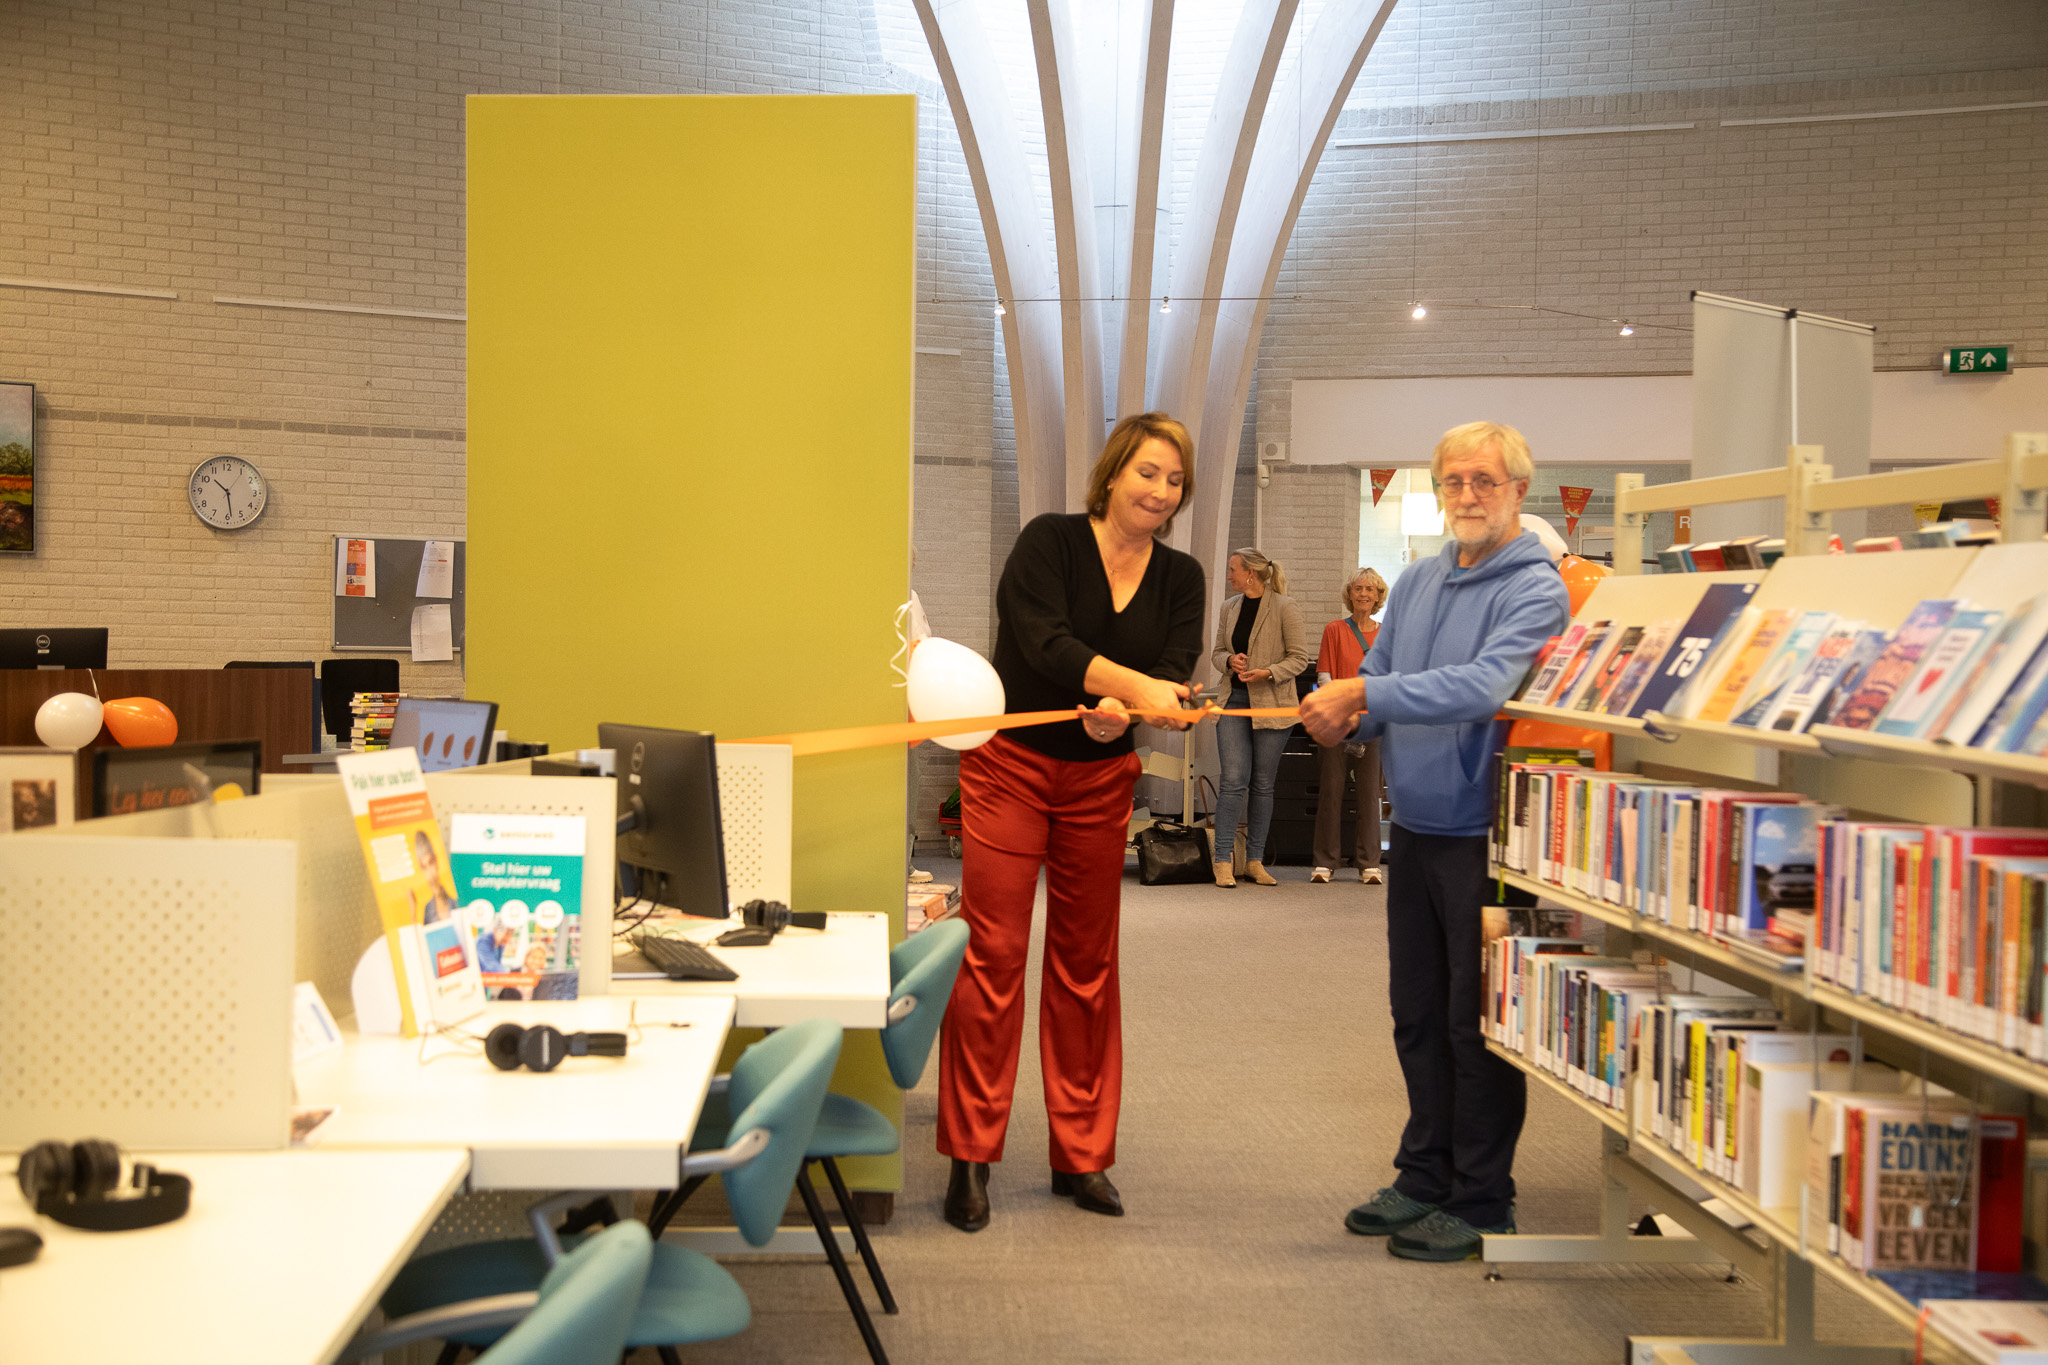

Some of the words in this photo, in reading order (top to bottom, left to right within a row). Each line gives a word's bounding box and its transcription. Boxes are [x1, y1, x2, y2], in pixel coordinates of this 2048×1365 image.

[211, 466, 217, 474] 11
[222, 463, 232, 471] 12
[201, 475, 210, 483] 10
[248, 476, 253, 484] 2
[197, 487, 203, 495] 9
[252, 489, 257, 497] 3
[201, 500, 207, 508] 8
[247, 501, 253, 509] 4
[212, 508, 217, 516] 7
[238, 510, 243, 518] 5
[1679, 515, 1691, 529] R
[1665, 636, 1712, 678] 75
[481, 861, 506, 876] Stel
[507, 861, 531, 876] hier
[532, 864, 552, 876] uw
[470, 876, 561, 893] computervraag
[1876, 1230, 1970, 1263] LEVEN
